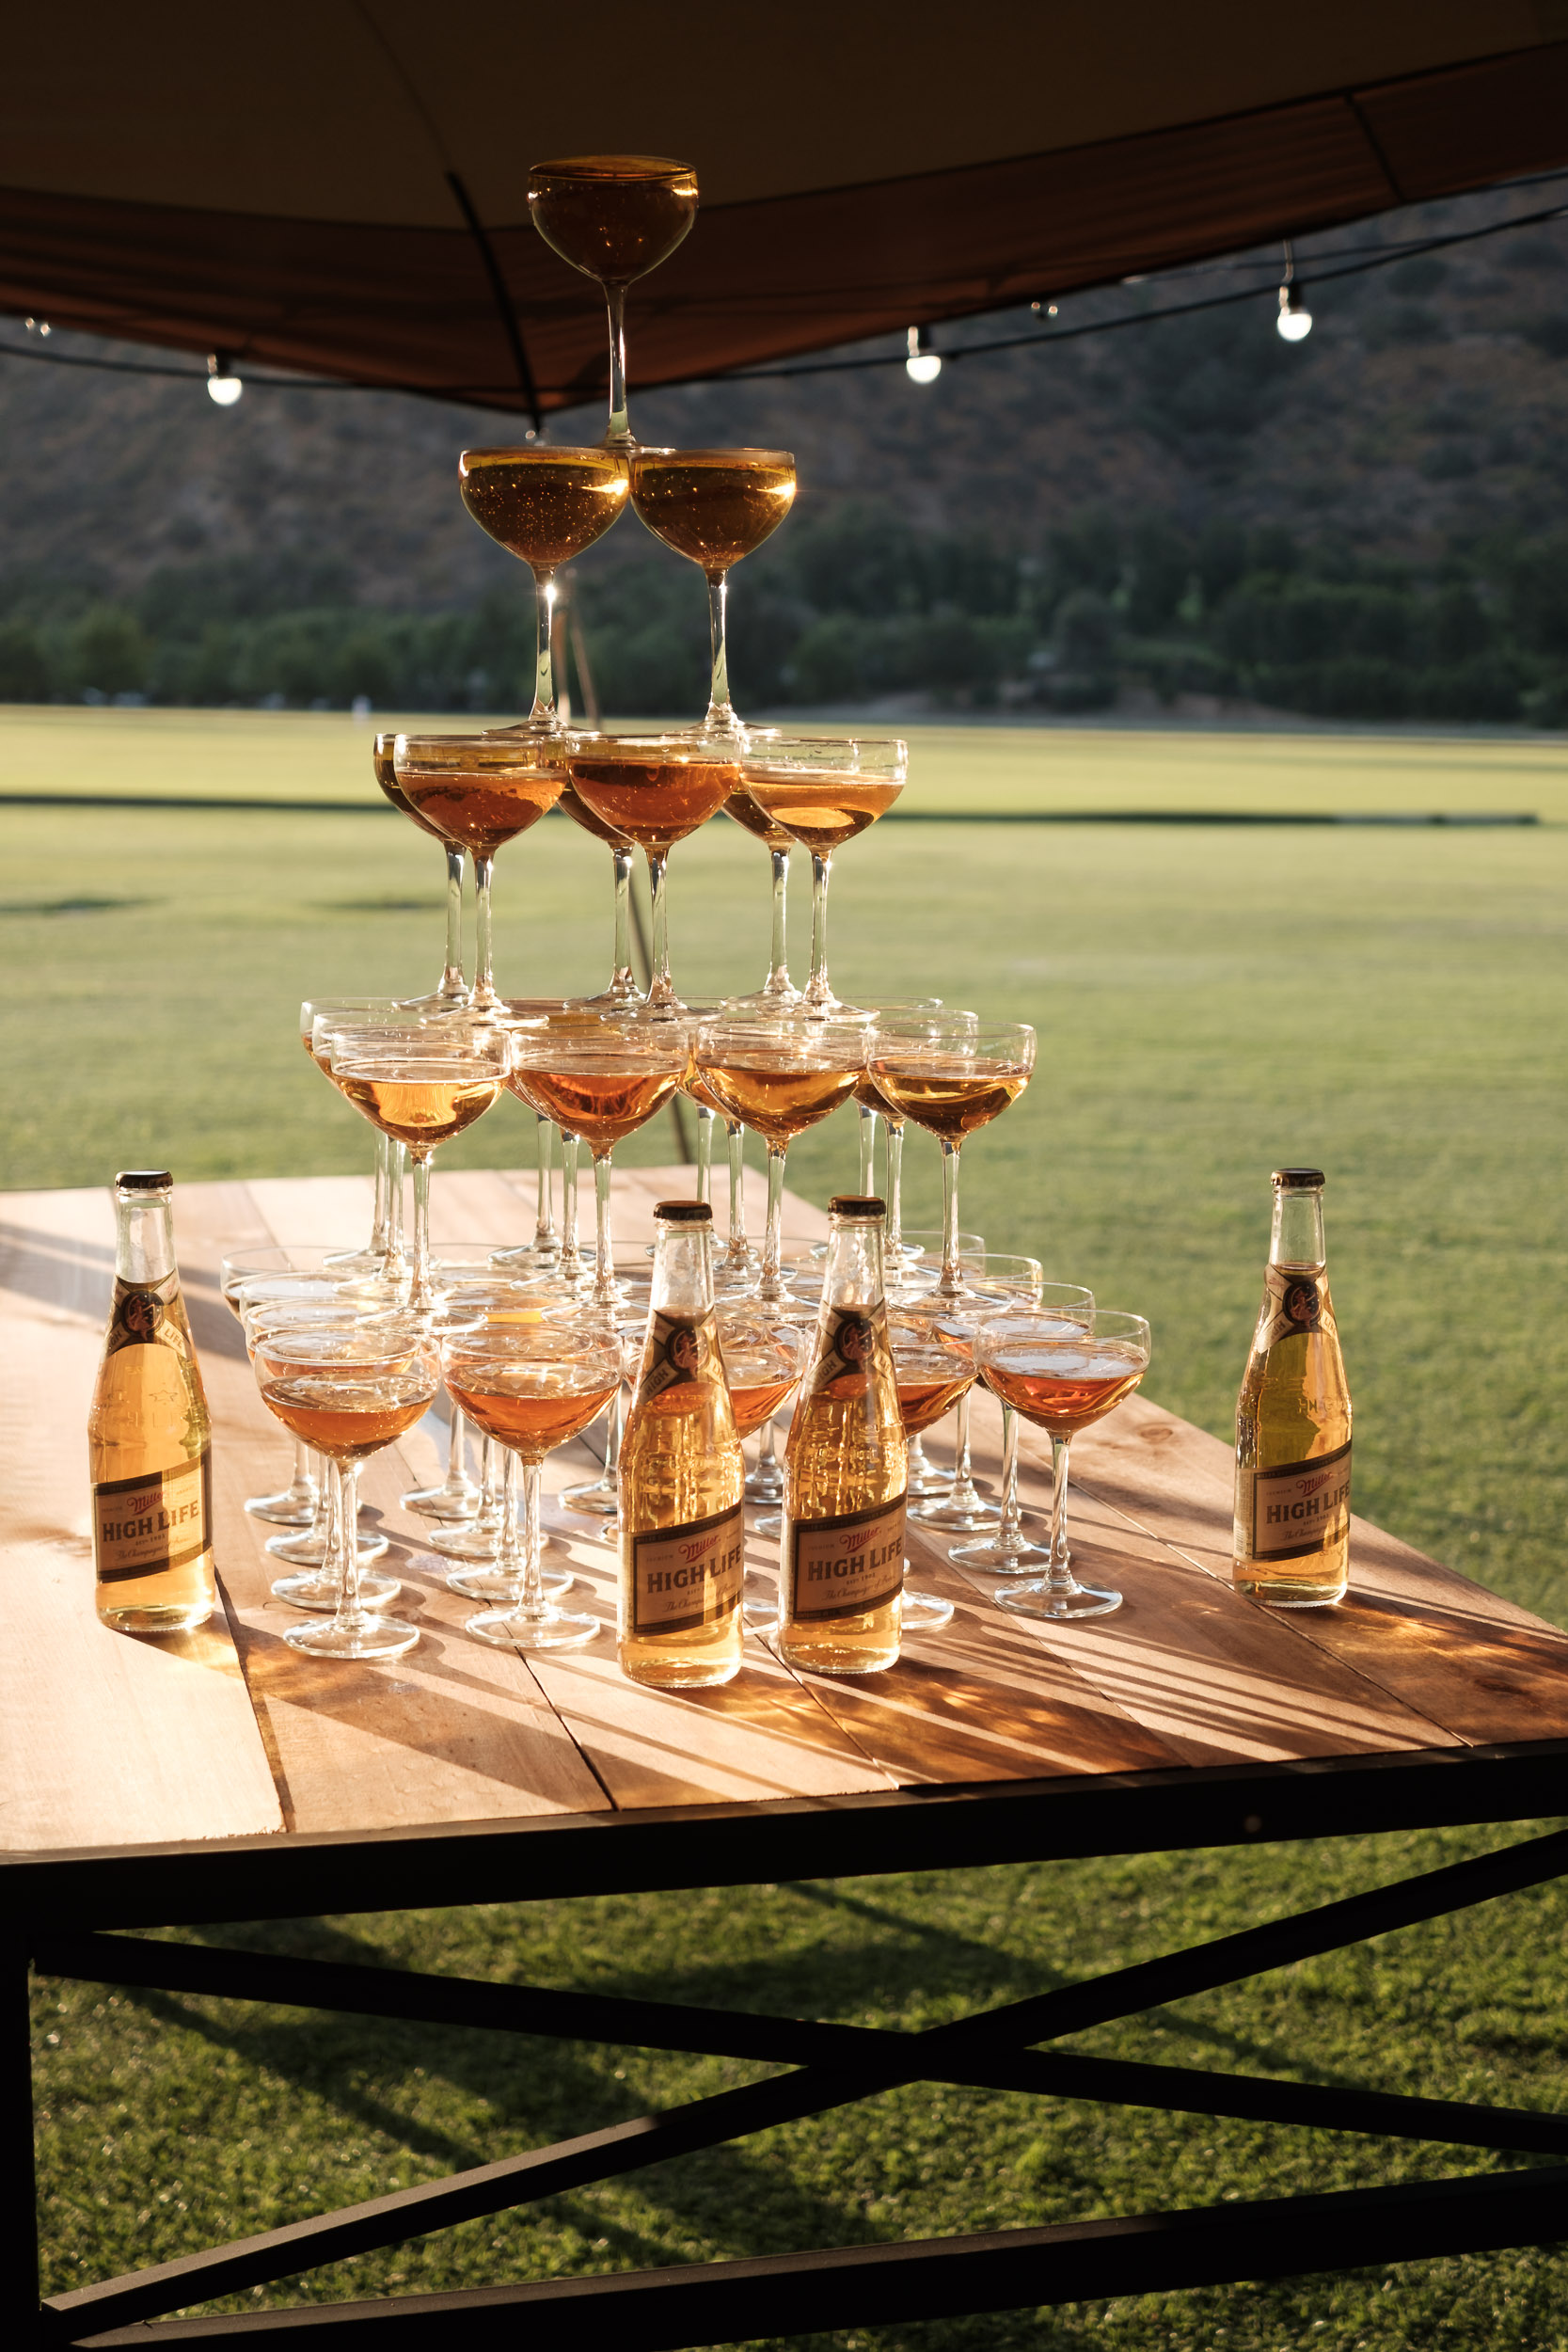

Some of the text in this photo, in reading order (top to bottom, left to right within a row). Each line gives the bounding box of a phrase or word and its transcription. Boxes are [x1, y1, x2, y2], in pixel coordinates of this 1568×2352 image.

[164, 1327, 185, 1348] LIFE
[644, 1368, 670, 1396] HIGH
[1296, 1471, 1334, 1498] Miller
[1266, 1497, 1320, 1524] HIGH
[1323, 1479, 1350, 1511] LIFE
[103, 1500, 199, 1543] HIGH LIFE
[678, 1534, 721, 1565] Miller
[839, 1526, 881, 1555] Miller
[647, 1543, 742, 1594] HIGH LIFE
[807, 1535, 902, 1581] HIGH LIFE
